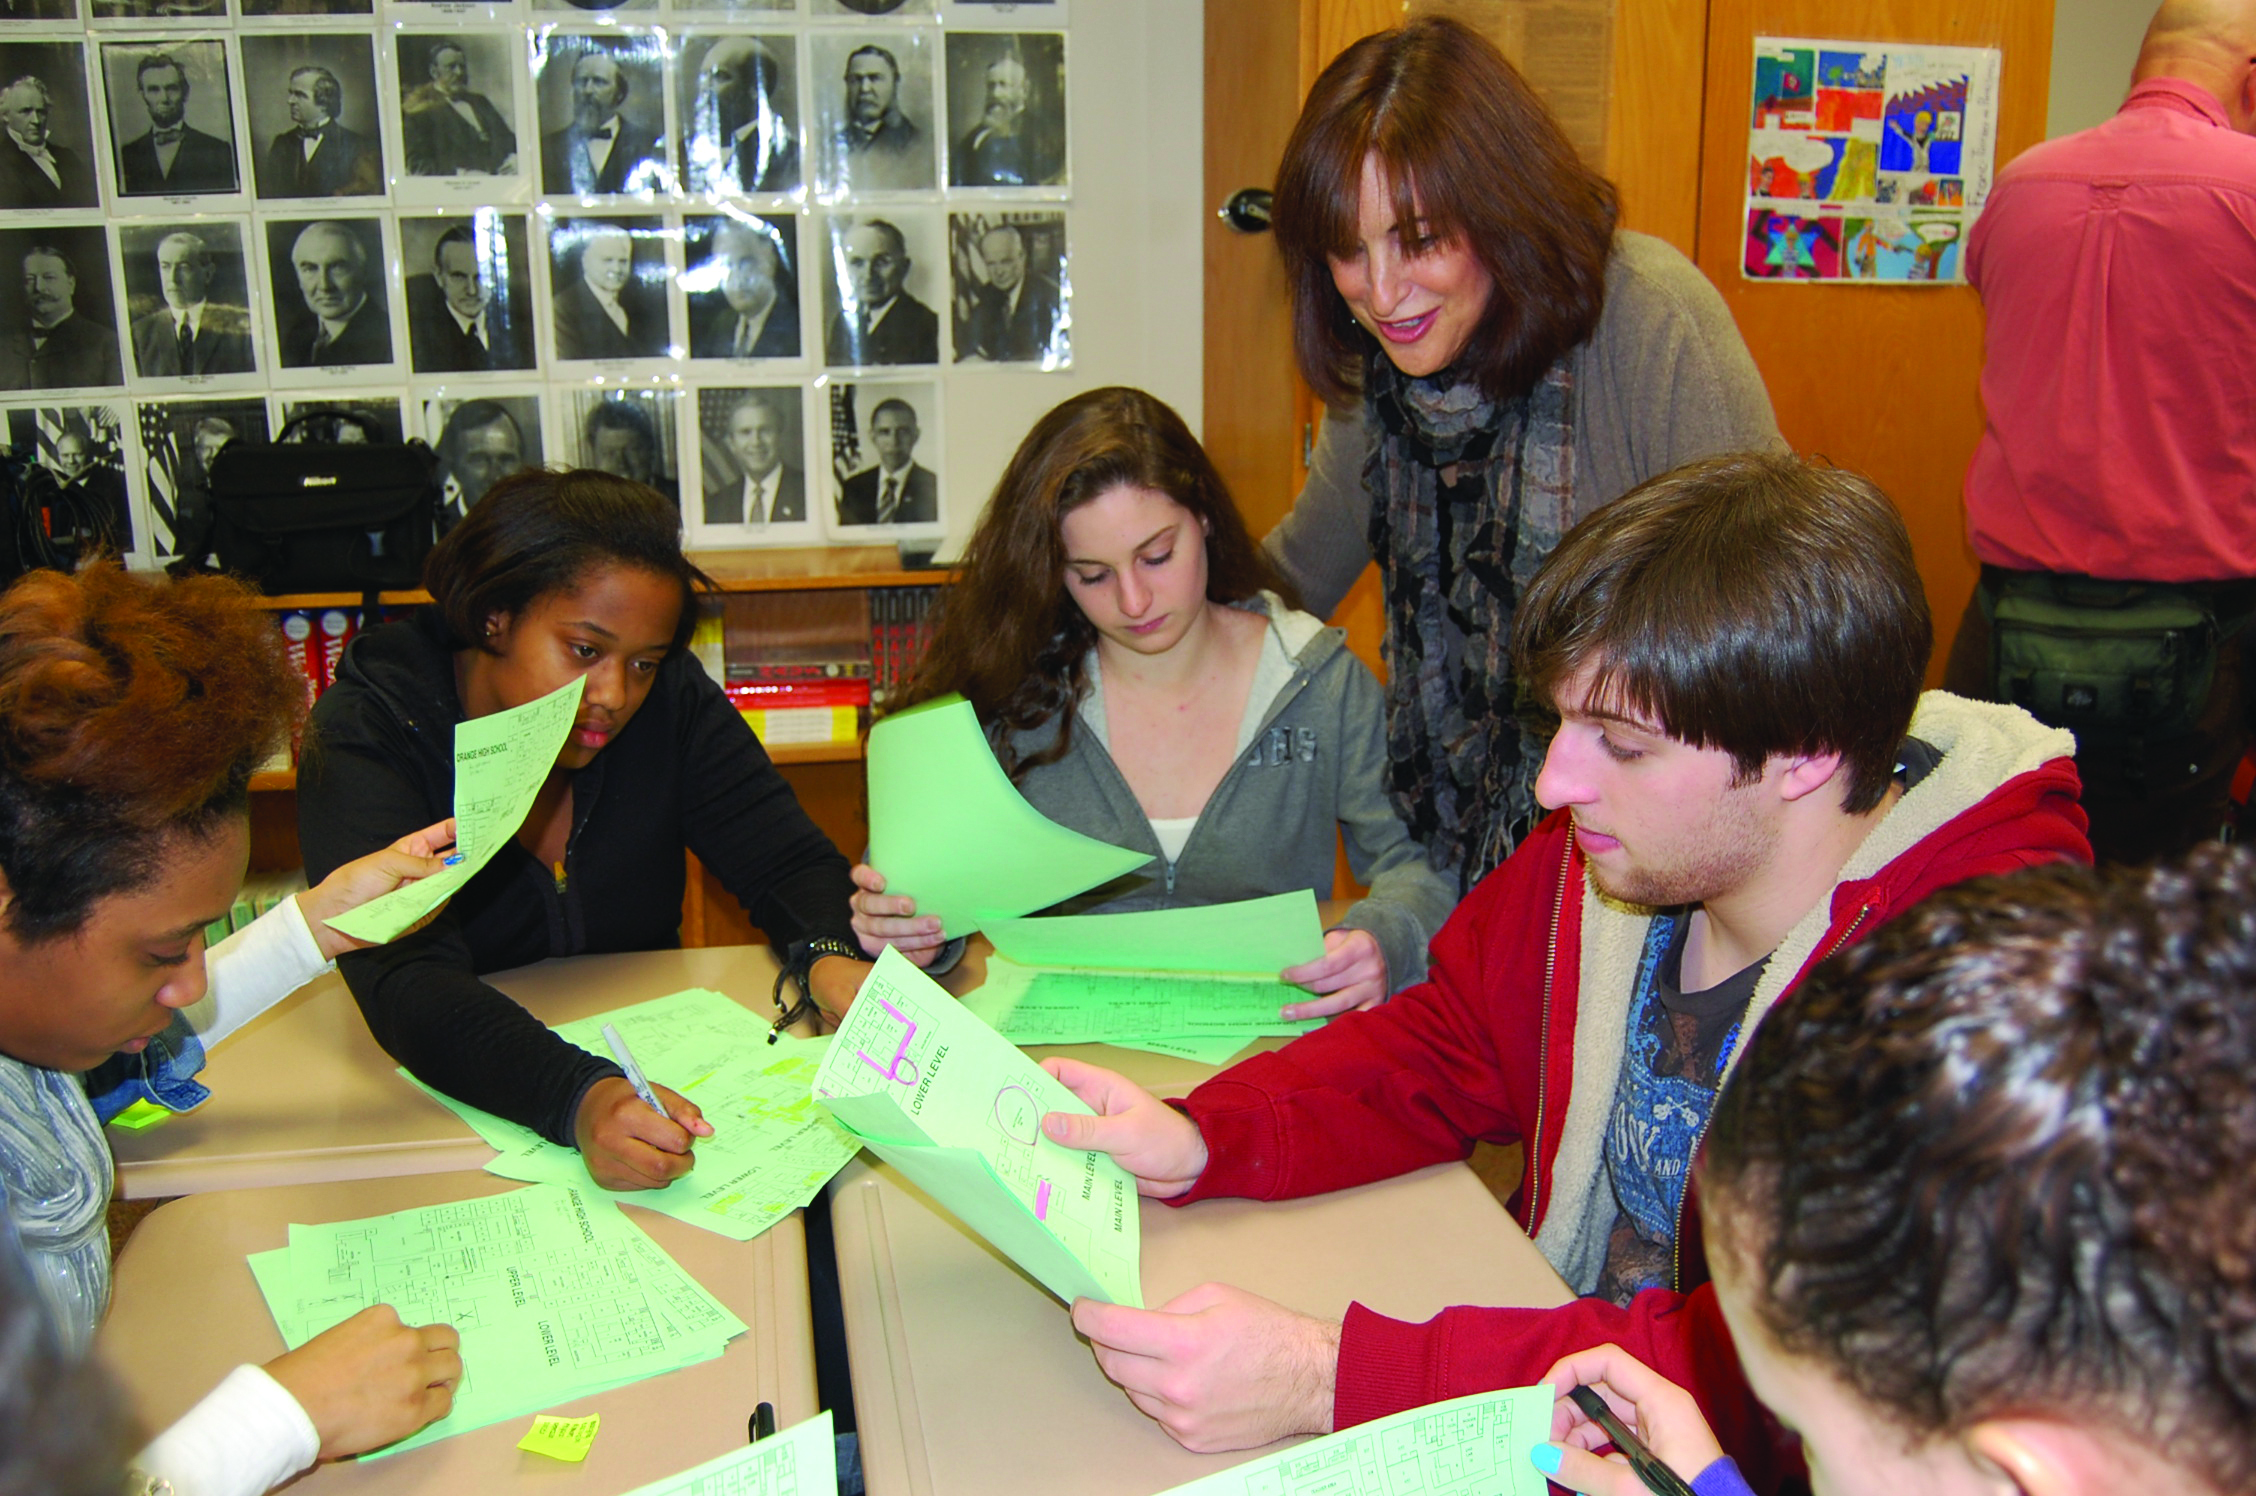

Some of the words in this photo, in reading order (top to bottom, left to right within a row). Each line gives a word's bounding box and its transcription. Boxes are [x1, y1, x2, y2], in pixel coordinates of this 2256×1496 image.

[910, 1077, 932, 1116] LOWER
[926, 1045, 949, 1078] LEVEL
[728, 1165, 762, 1185] LOWER
[1085, 1151, 1097, 1177] LEVEL
[1655, 1159, 1681, 1176] AND
[699, 1183, 731, 1200] LEVEL
[1081, 1176, 1093, 1201] MAIN
[1114, 1179, 1123, 1208] LEVEL
[1114, 1207, 1123, 1232] MAIN
[579, 1220, 594, 1243] SCHOOL
[506, 1266, 521, 1287] UPPER
[512, 1287, 526, 1308] LEVEL
[538, 1320, 554, 1345] LOWER
[545, 1345, 560, 1367] LEVEL
